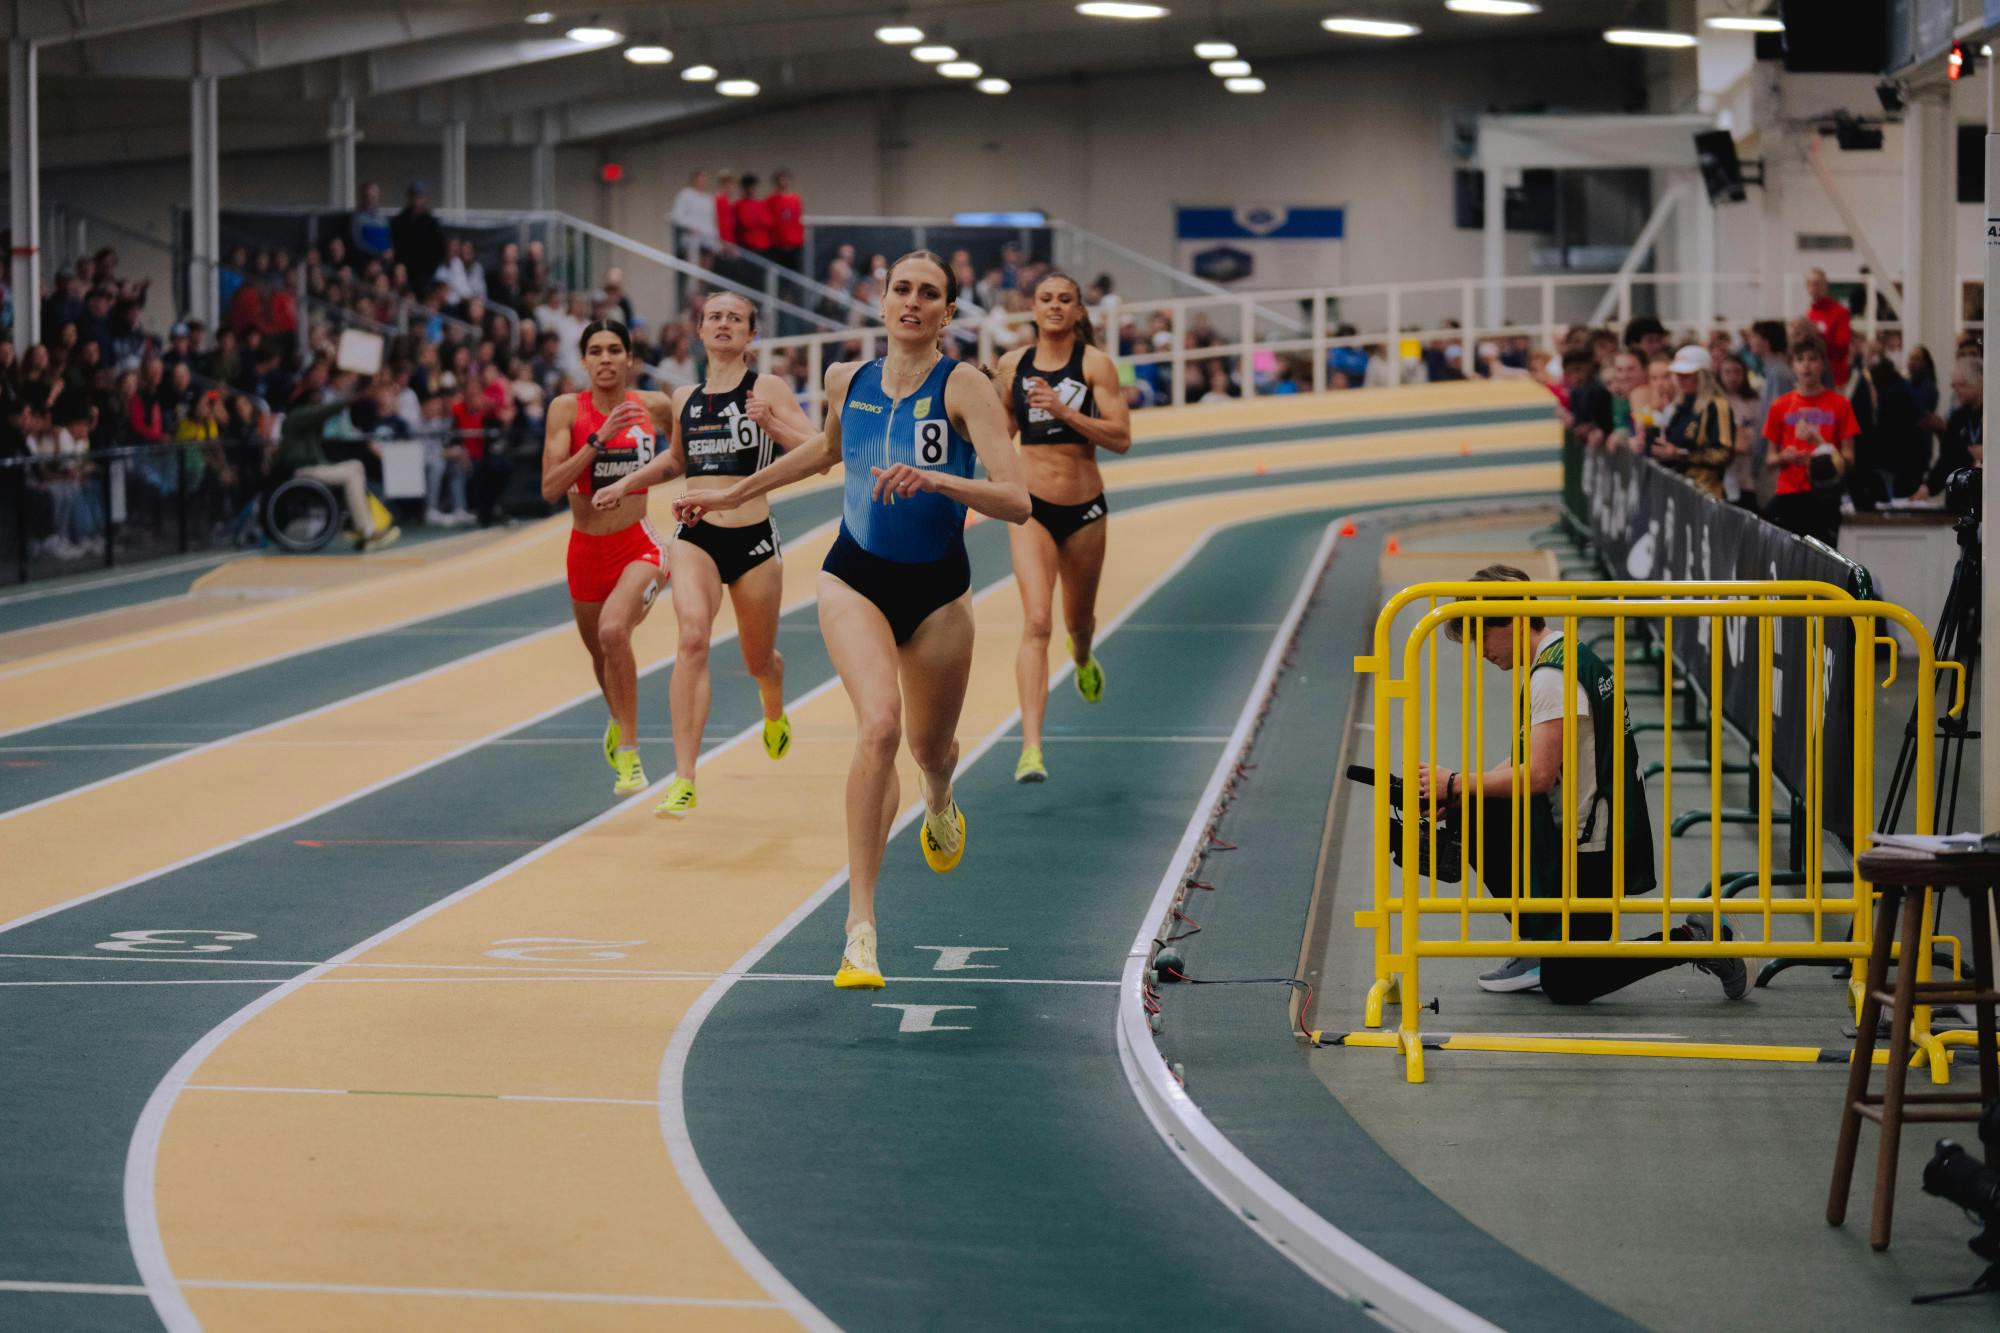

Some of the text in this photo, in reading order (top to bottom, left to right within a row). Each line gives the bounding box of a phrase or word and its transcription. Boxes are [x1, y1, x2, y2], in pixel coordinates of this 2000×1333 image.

[849, 400, 883, 414] BROOKS
[1066, 384, 1081, 406] 7
[738, 416, 753, 447] 6
[922, 423, 942, 463] 8
[643, 437, 651, 464] 5
[594, 461, 640, 477] SUMNE
[94, 930, 259, 953] 3
[481, 937, 648, 962] 2
[913, 945, 1009, 971] 1
[871, 1003, 977, 1032] 1
